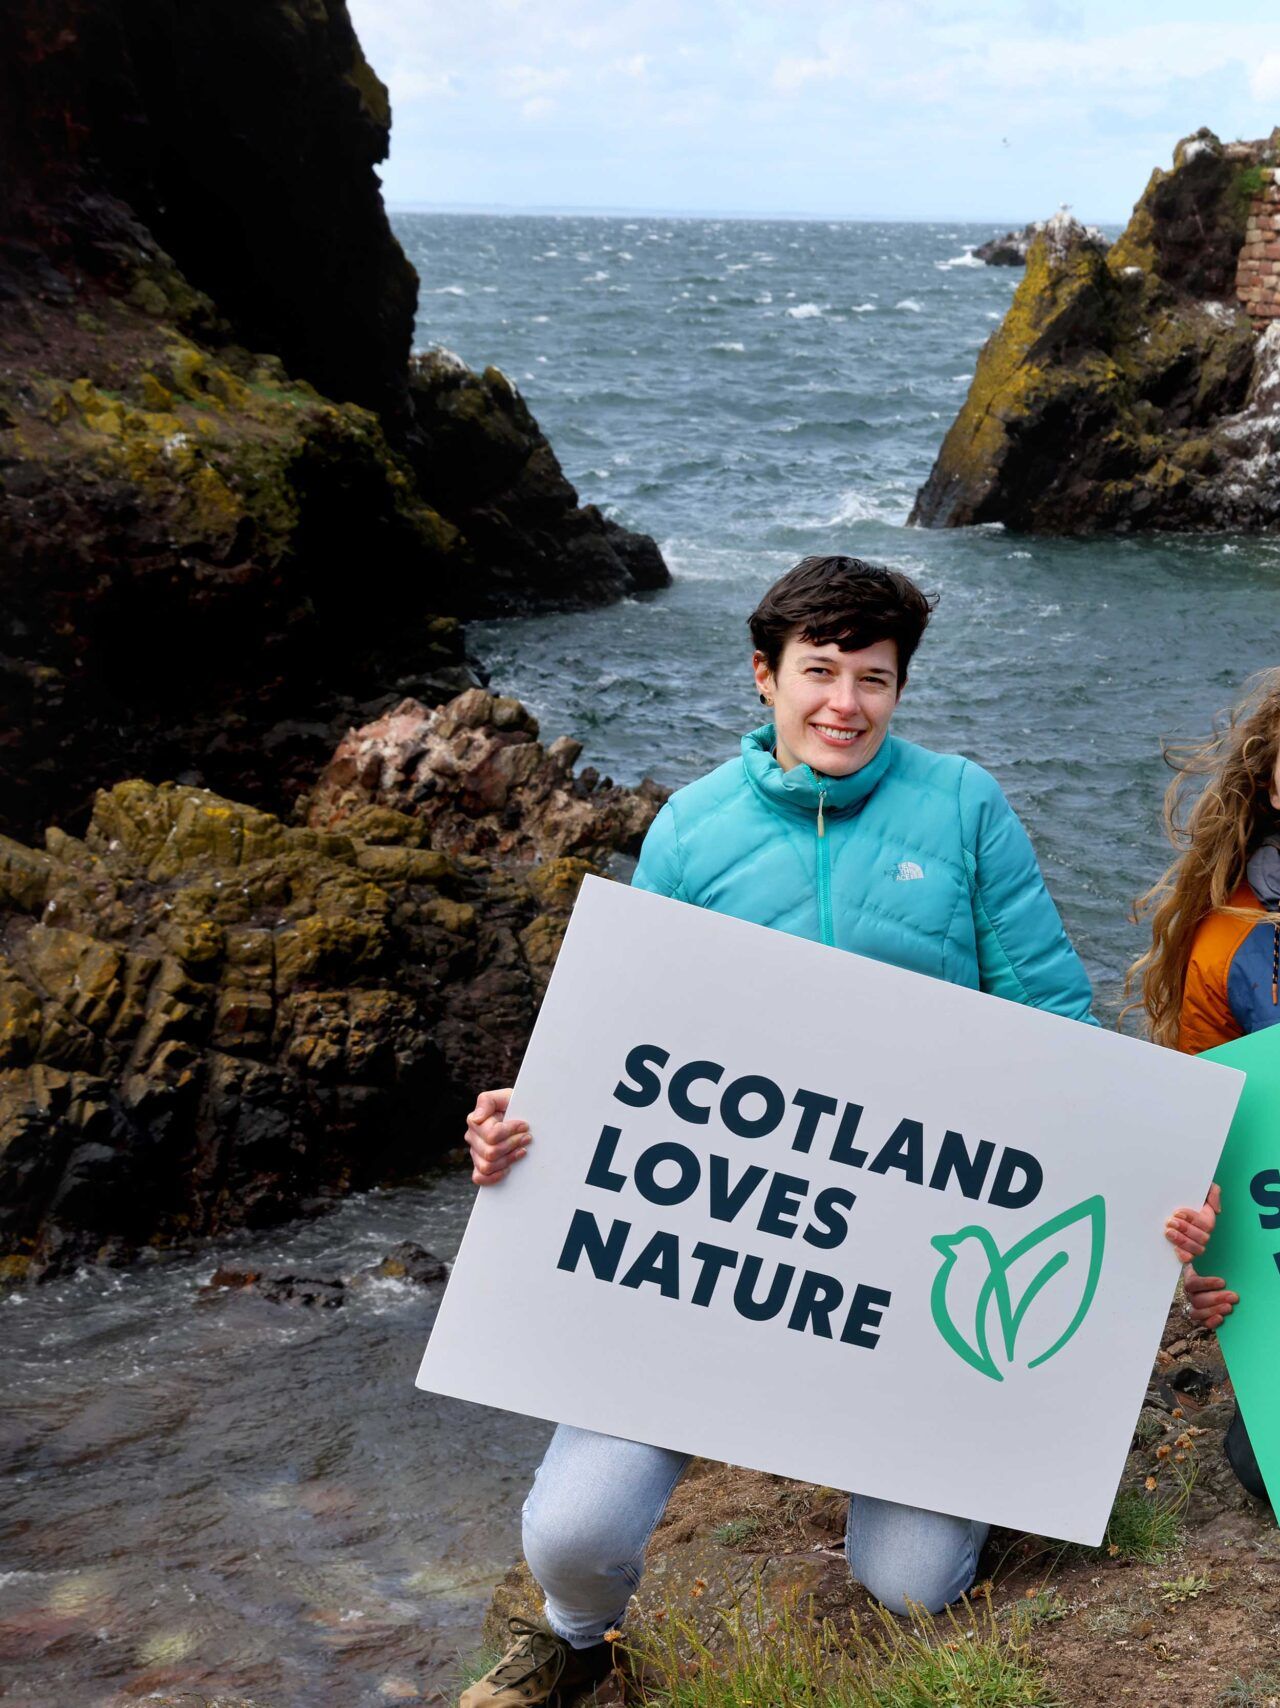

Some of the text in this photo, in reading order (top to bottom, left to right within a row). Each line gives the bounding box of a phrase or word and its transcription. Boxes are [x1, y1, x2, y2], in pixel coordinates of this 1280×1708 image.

[584, 1124, 857, 1250] LOVES
[612, 1044, 1044, 1210] SCOTLAND
[556, 1208, 892, 1350] NATURE
